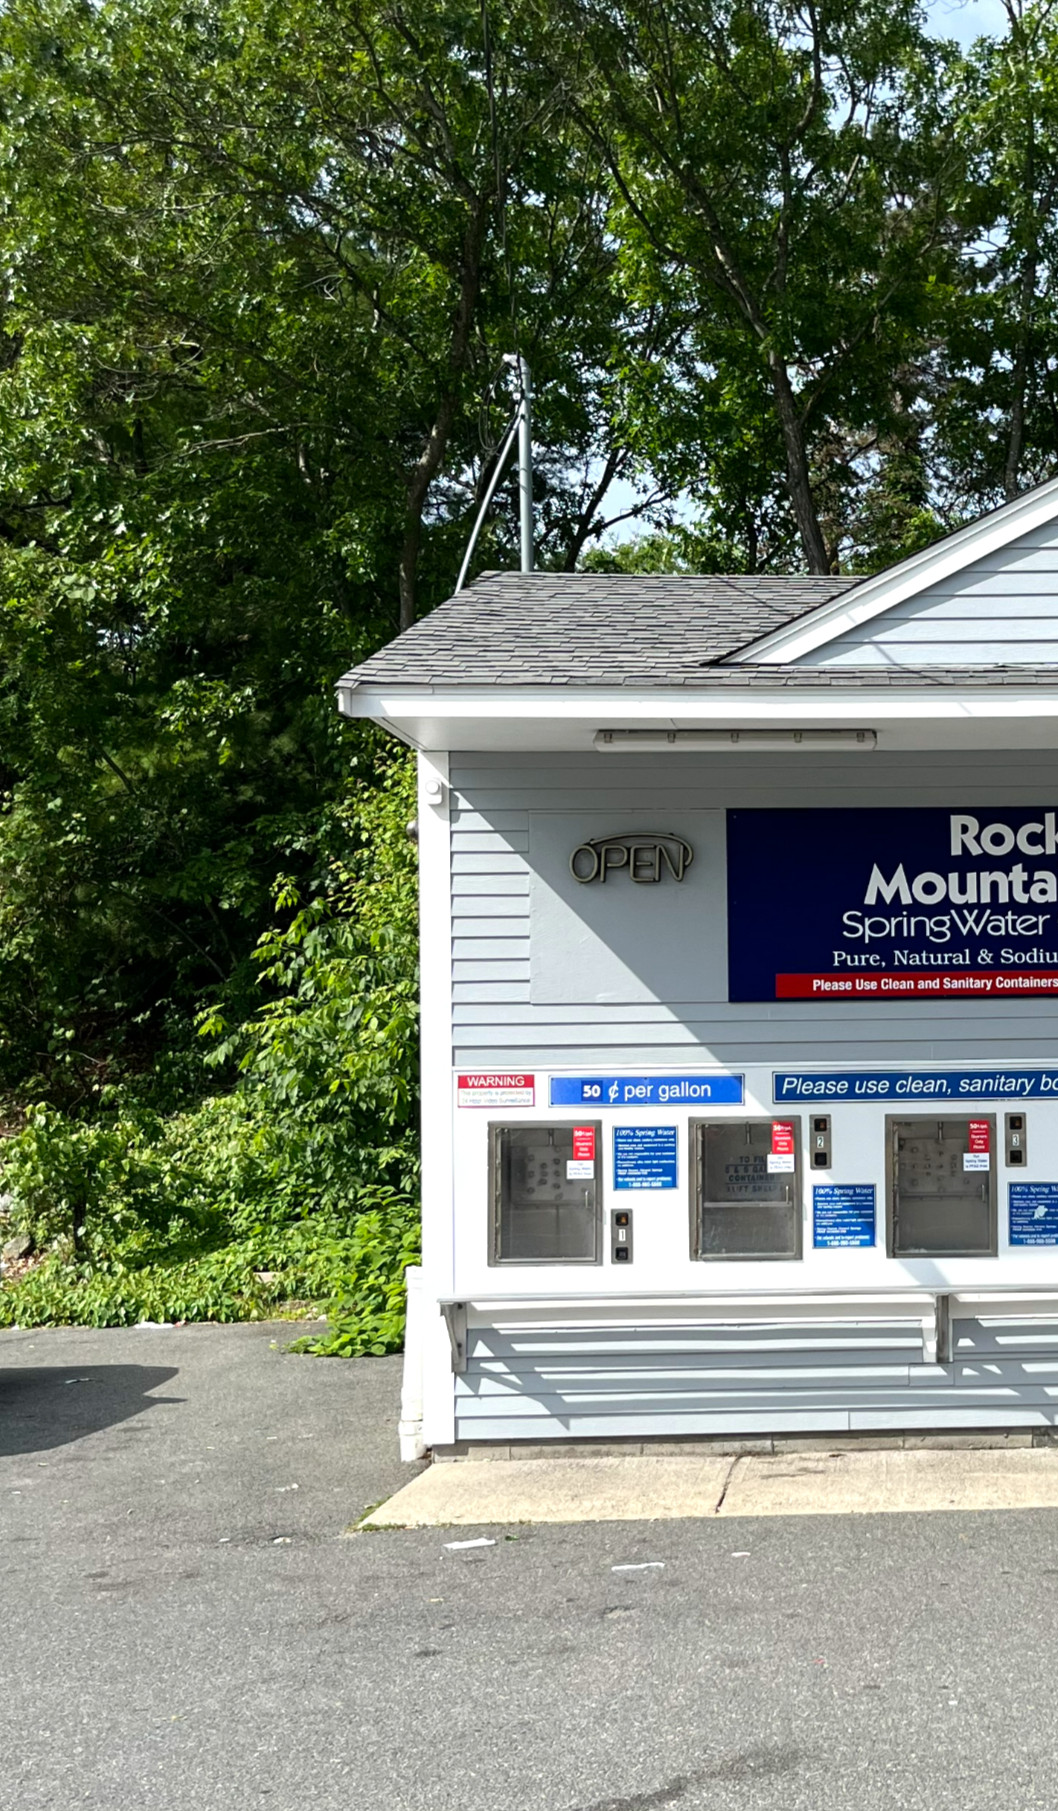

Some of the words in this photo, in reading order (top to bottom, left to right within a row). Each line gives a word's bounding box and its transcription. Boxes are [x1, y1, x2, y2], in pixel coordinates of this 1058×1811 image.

[569, 843, 688, 884] OPEN
[833, 951, 886, 968] Pure,
[894, 949, 970, 966] Natural
[977, 949, 994, 964] &
[812, 979, 852, 991] Please
[855, 978, 877, 990] Use
[881, 978, 914, 990] Clean
[918, 978, 940, 989] and
[943, 977, 992, 991] Sanitary
[467, 1076, 525, 1087] WARNING
[782, 1076, 848, 1094] Please
[855, 1080, 889, 1093] use
[895, 1076, 951, 1095] clean,
[958, 1075, 1035, 1095] sanitary
[582, 1085, 601, 1098] 50
[608, 1081, 619, 1103] ¢
[624, 1083, 654, 1100] per
[658, 1081, 712, 1100] gallon
[818, 1137, 823, 1147] 2
[1013, 1135, 1018, 1145] 3
[753, 1155, 766, 1163] FIL
